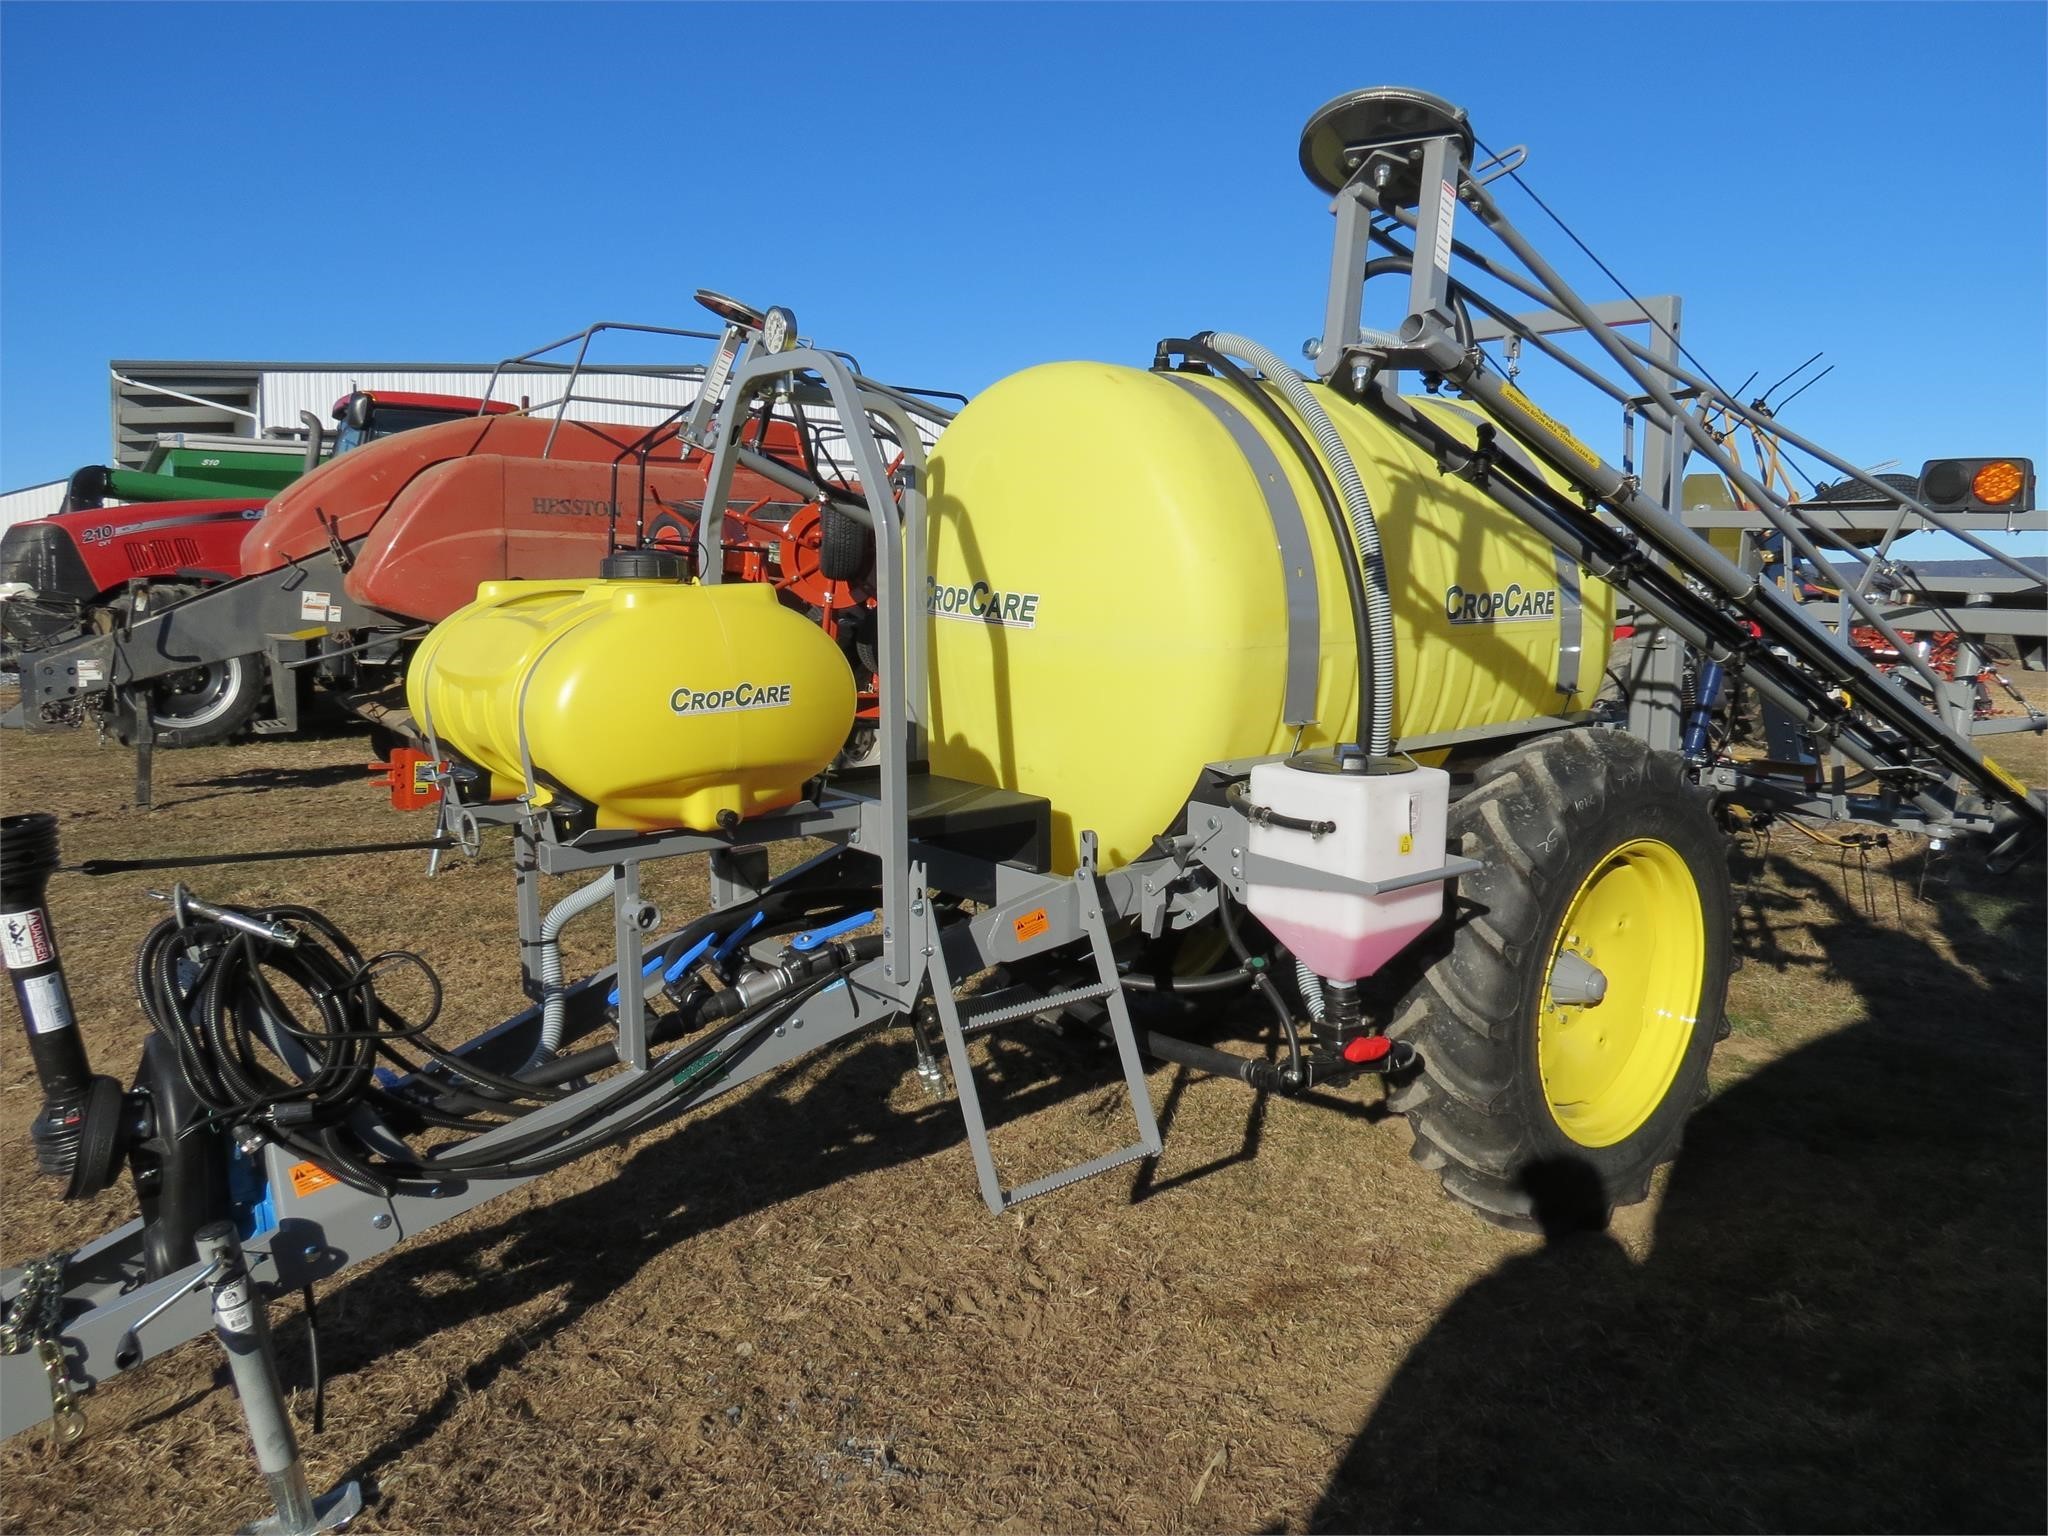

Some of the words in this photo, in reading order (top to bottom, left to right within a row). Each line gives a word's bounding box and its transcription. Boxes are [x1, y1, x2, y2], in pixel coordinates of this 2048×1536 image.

[242, 510, 267, 520] CA
[532, 496, 623, 518] HESSTON
[82, 525, 113, 543] 210
[31, 925, 49, 961] DANGER
